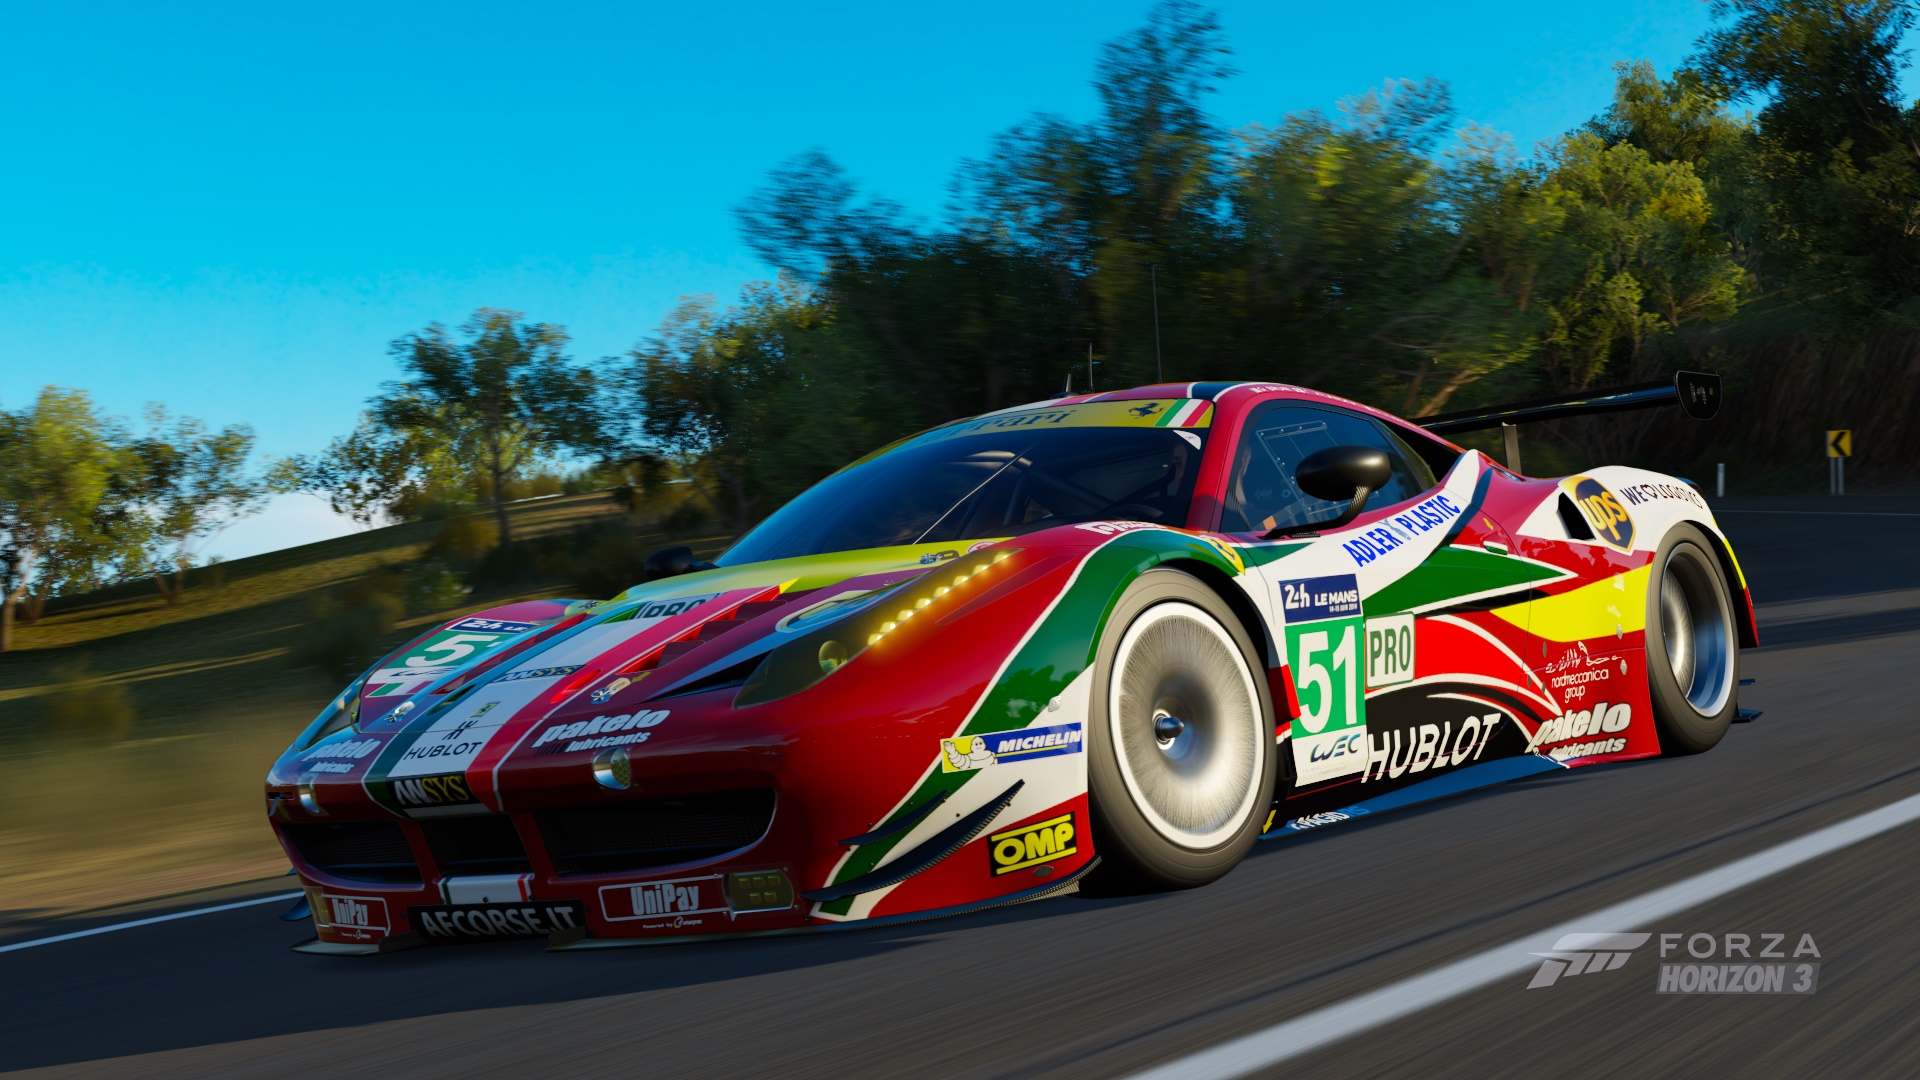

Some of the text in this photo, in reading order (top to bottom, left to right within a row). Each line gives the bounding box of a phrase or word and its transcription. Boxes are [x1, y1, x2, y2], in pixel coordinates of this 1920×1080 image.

[1619, 484, 1649, 505] WE
[1342, 495, 1461, 567] ADLER PLASTIC
[1578, 491, 1627, 541] ups
[1284, 583, 1358, 610] 24h LE MANS
[405, 633, 502, 668] 5
[1369, 625, 1411, 678] PRO
[1298, 625, 1357, 733] 51
[1551, 667, 1609, 688] nordmeccanica
[1564, 685, 1586, 703] group
[531, 709, 671, 749] pakelo
[565, 732, 652, 753] lubricants
[997, 730, 1082, 753] MICHELIN
[1524, 702, 1632, 754] pakelo
[402, 741, 482, 760] HUBLOT
[1310, 733, 1361, 763] WEC
[1361, 713, 1502, 784] HUBLOT
[394, 775, 469, 805] ANSYS
[993, 822, 1075, 866] OMP
[332, 897, 369, 926] UniPay
[630, 883, 699, 916] UniPay
[421, 906, 574, 937] AFCORSE.IT
